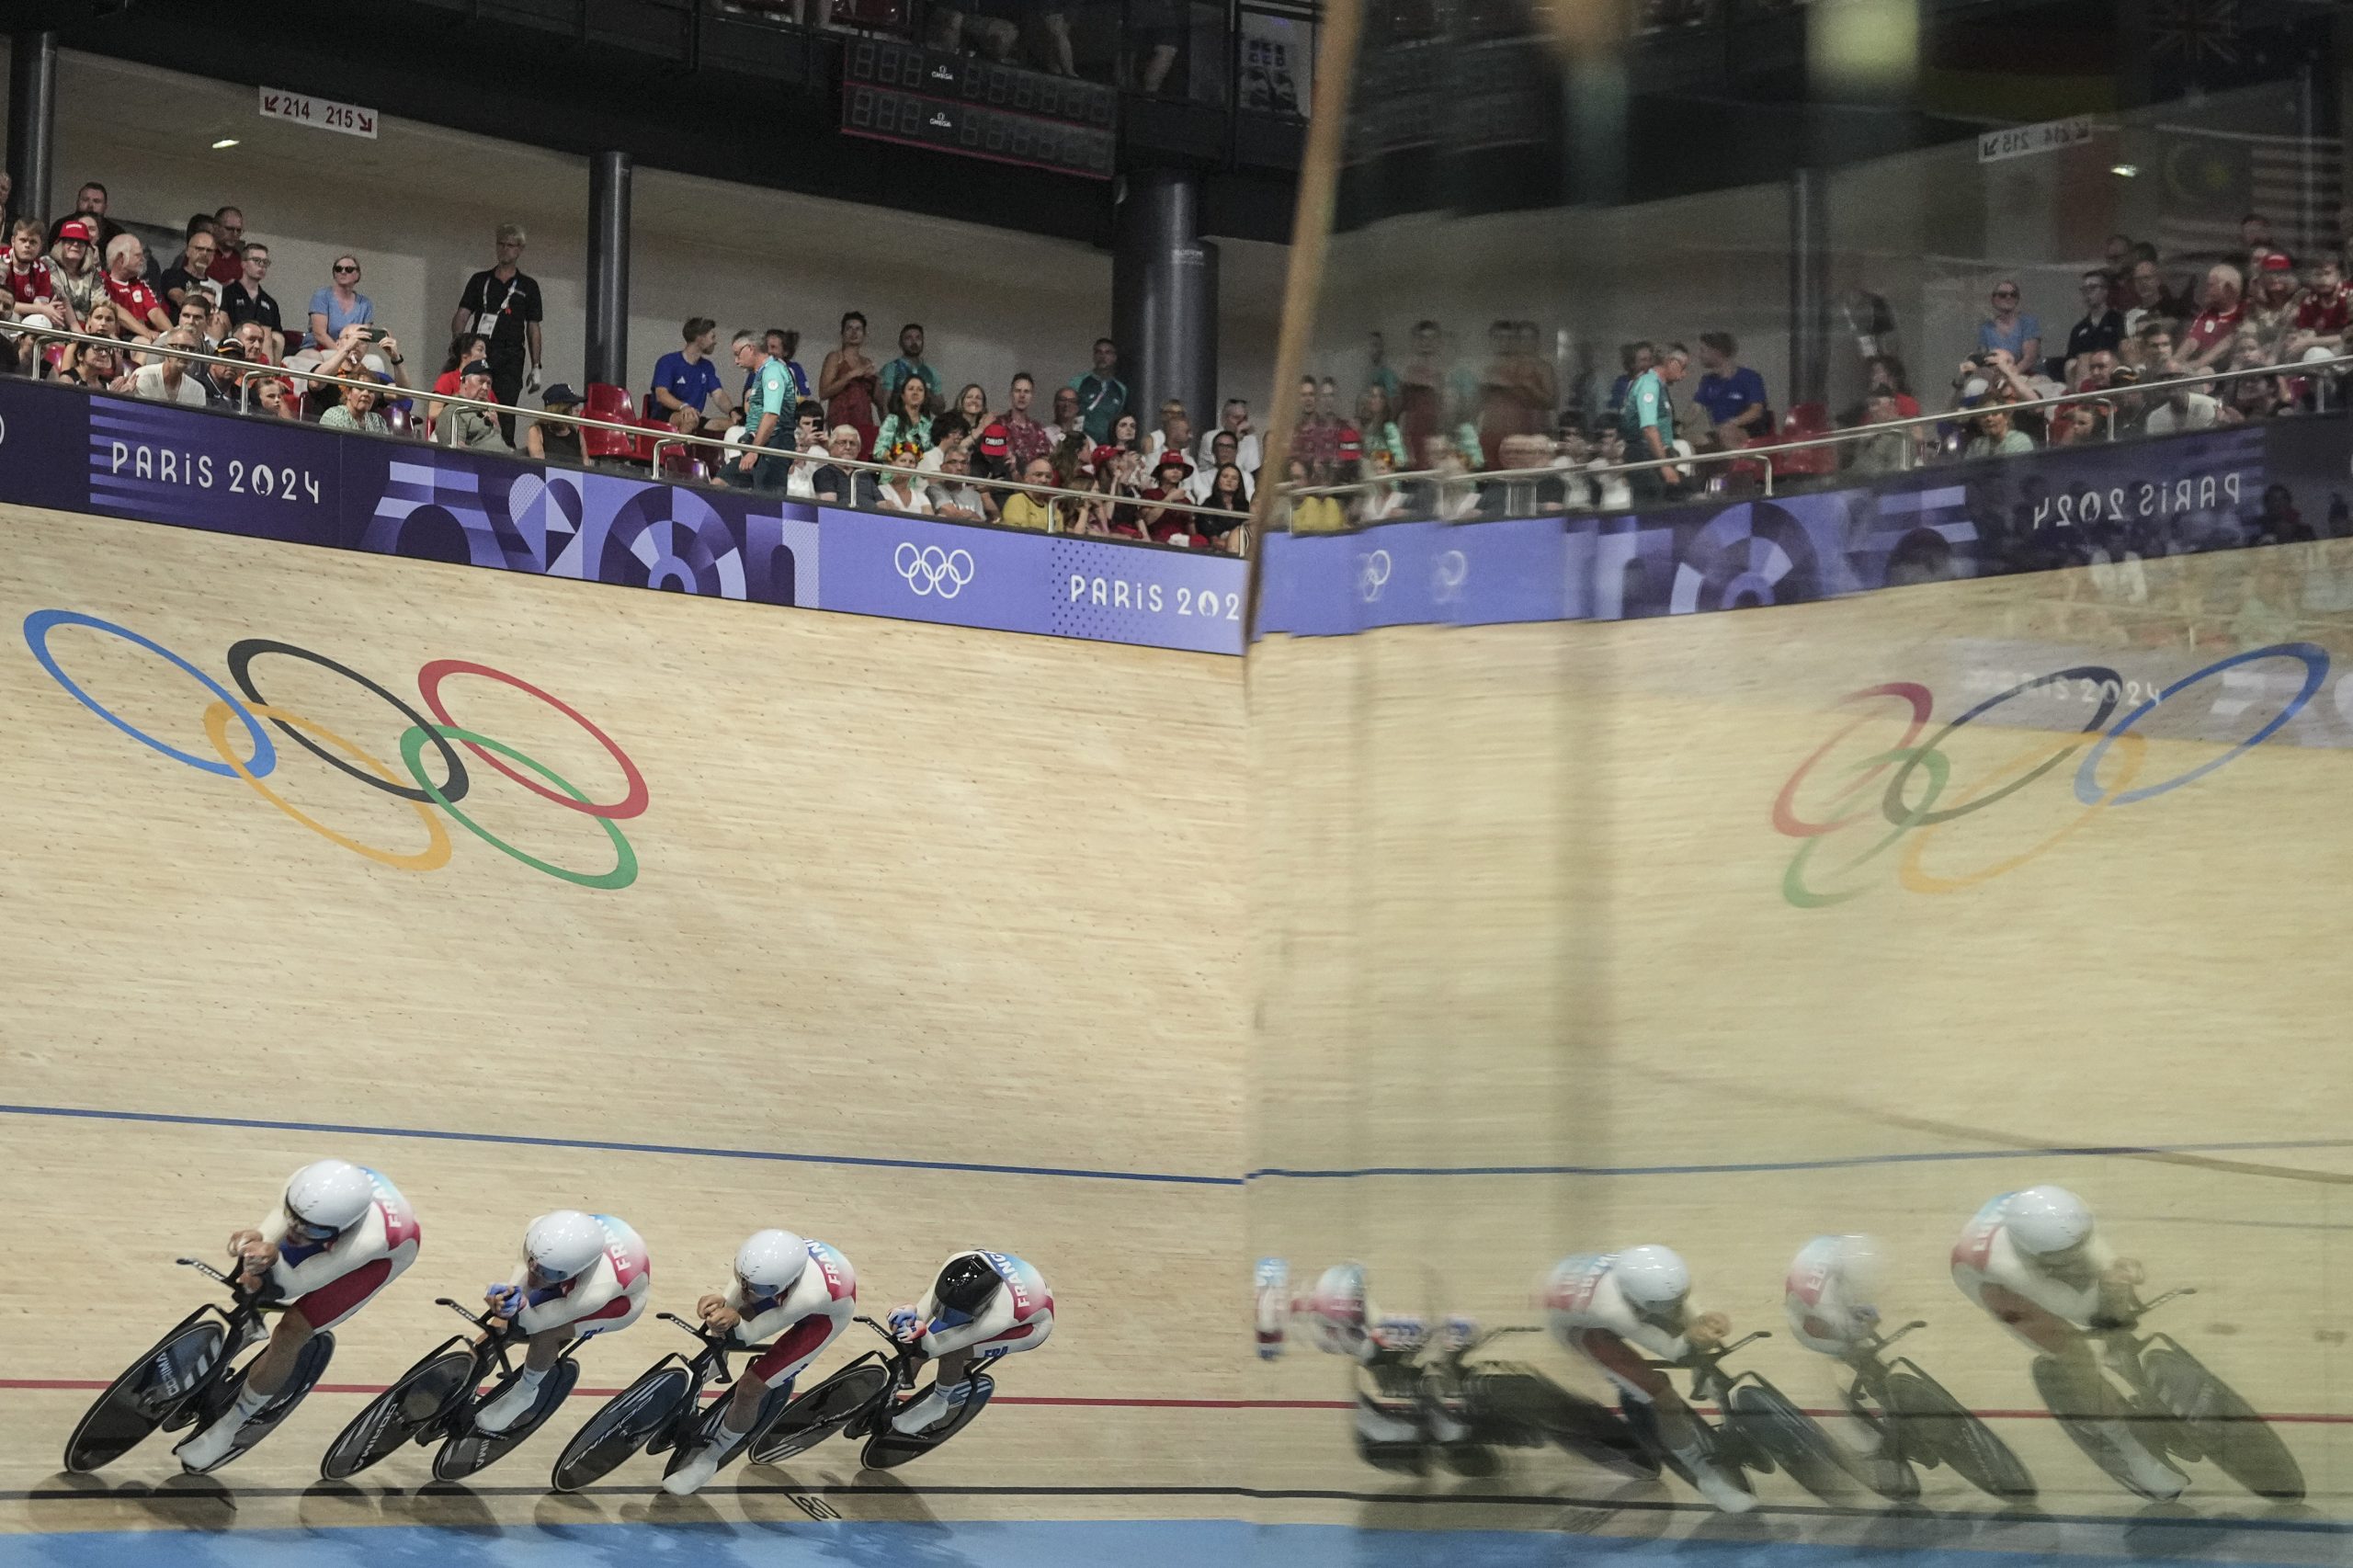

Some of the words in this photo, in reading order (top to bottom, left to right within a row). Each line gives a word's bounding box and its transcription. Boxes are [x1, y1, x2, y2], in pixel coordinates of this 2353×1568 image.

[283, 97, 310, 119] 214
[325, 106, 353, 128] 215
[229, 460, 319, 504] 2024
[1176, 587, 1240, 620] 202
